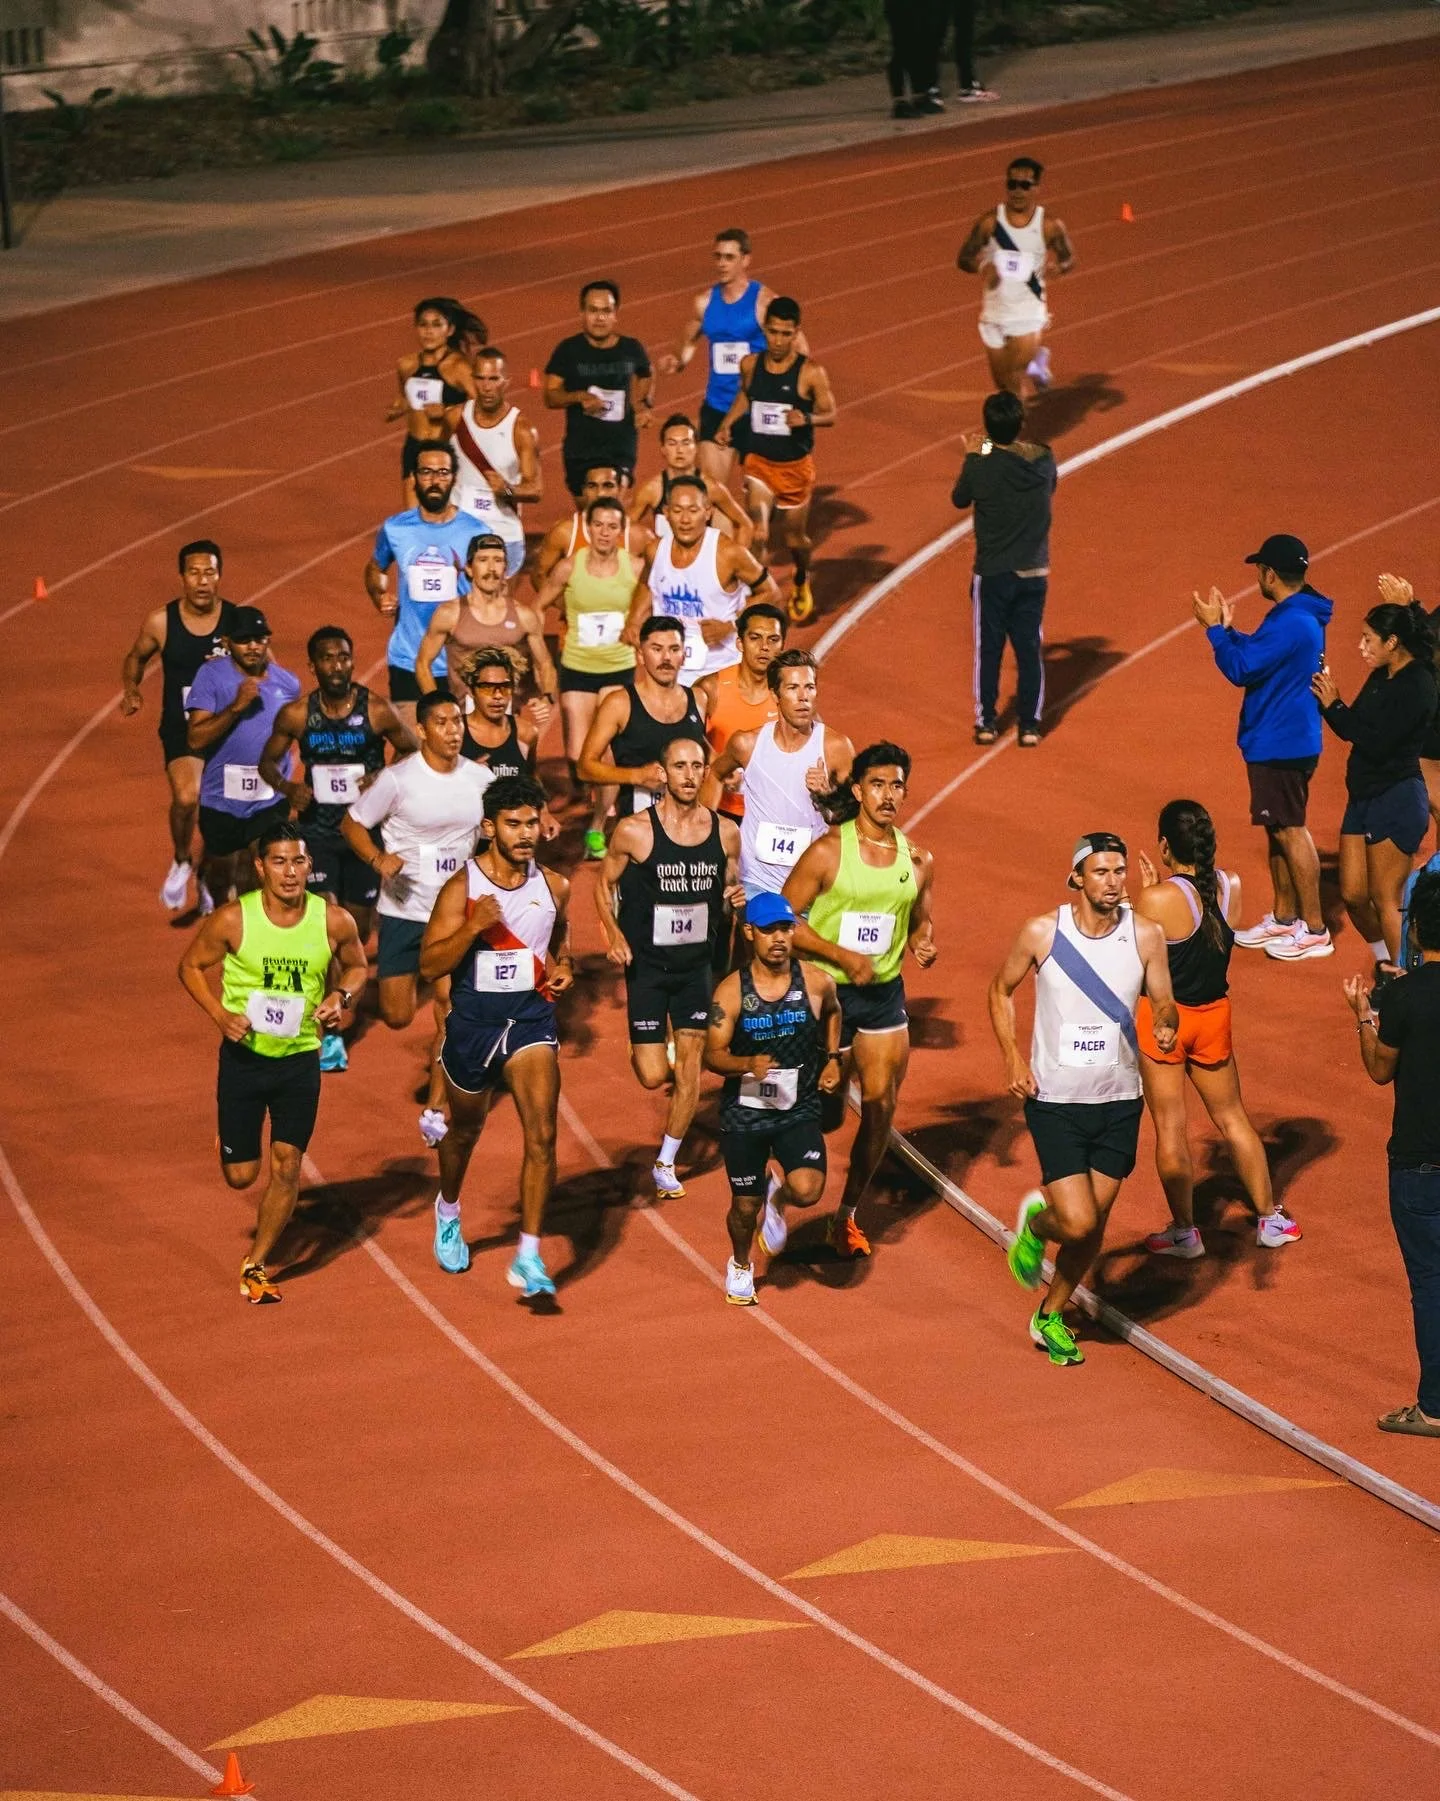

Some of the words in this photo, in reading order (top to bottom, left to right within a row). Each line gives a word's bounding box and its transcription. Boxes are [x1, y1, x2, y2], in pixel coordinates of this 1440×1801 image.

[422, 578, 442, 591] 156
[596, 624, 605, 637] 7
[241, 777, 259, 791] 131
[330, 779, 348, 793] 65
[771, 837, 796, 855] 144
[436, 858, 457, 873] 140
[656, 860, 687, 880] good
[689, 860, 719, 878] vibes
[659, 877, 689, 893] track
[691, 876, 713, 892] club
[671, 918, 693, 935] 134
[857, 926, 880, 943] 126
[495, 963, 518, 981] 127
[264, 1006, 285, 1025] 59
[743, 1013, 774, 1033] good
[776, 1009, 807, 1025] vibes
[1073, 1040, 1106, 1052] PACER
[759, 1083, 779, 1098] 101
